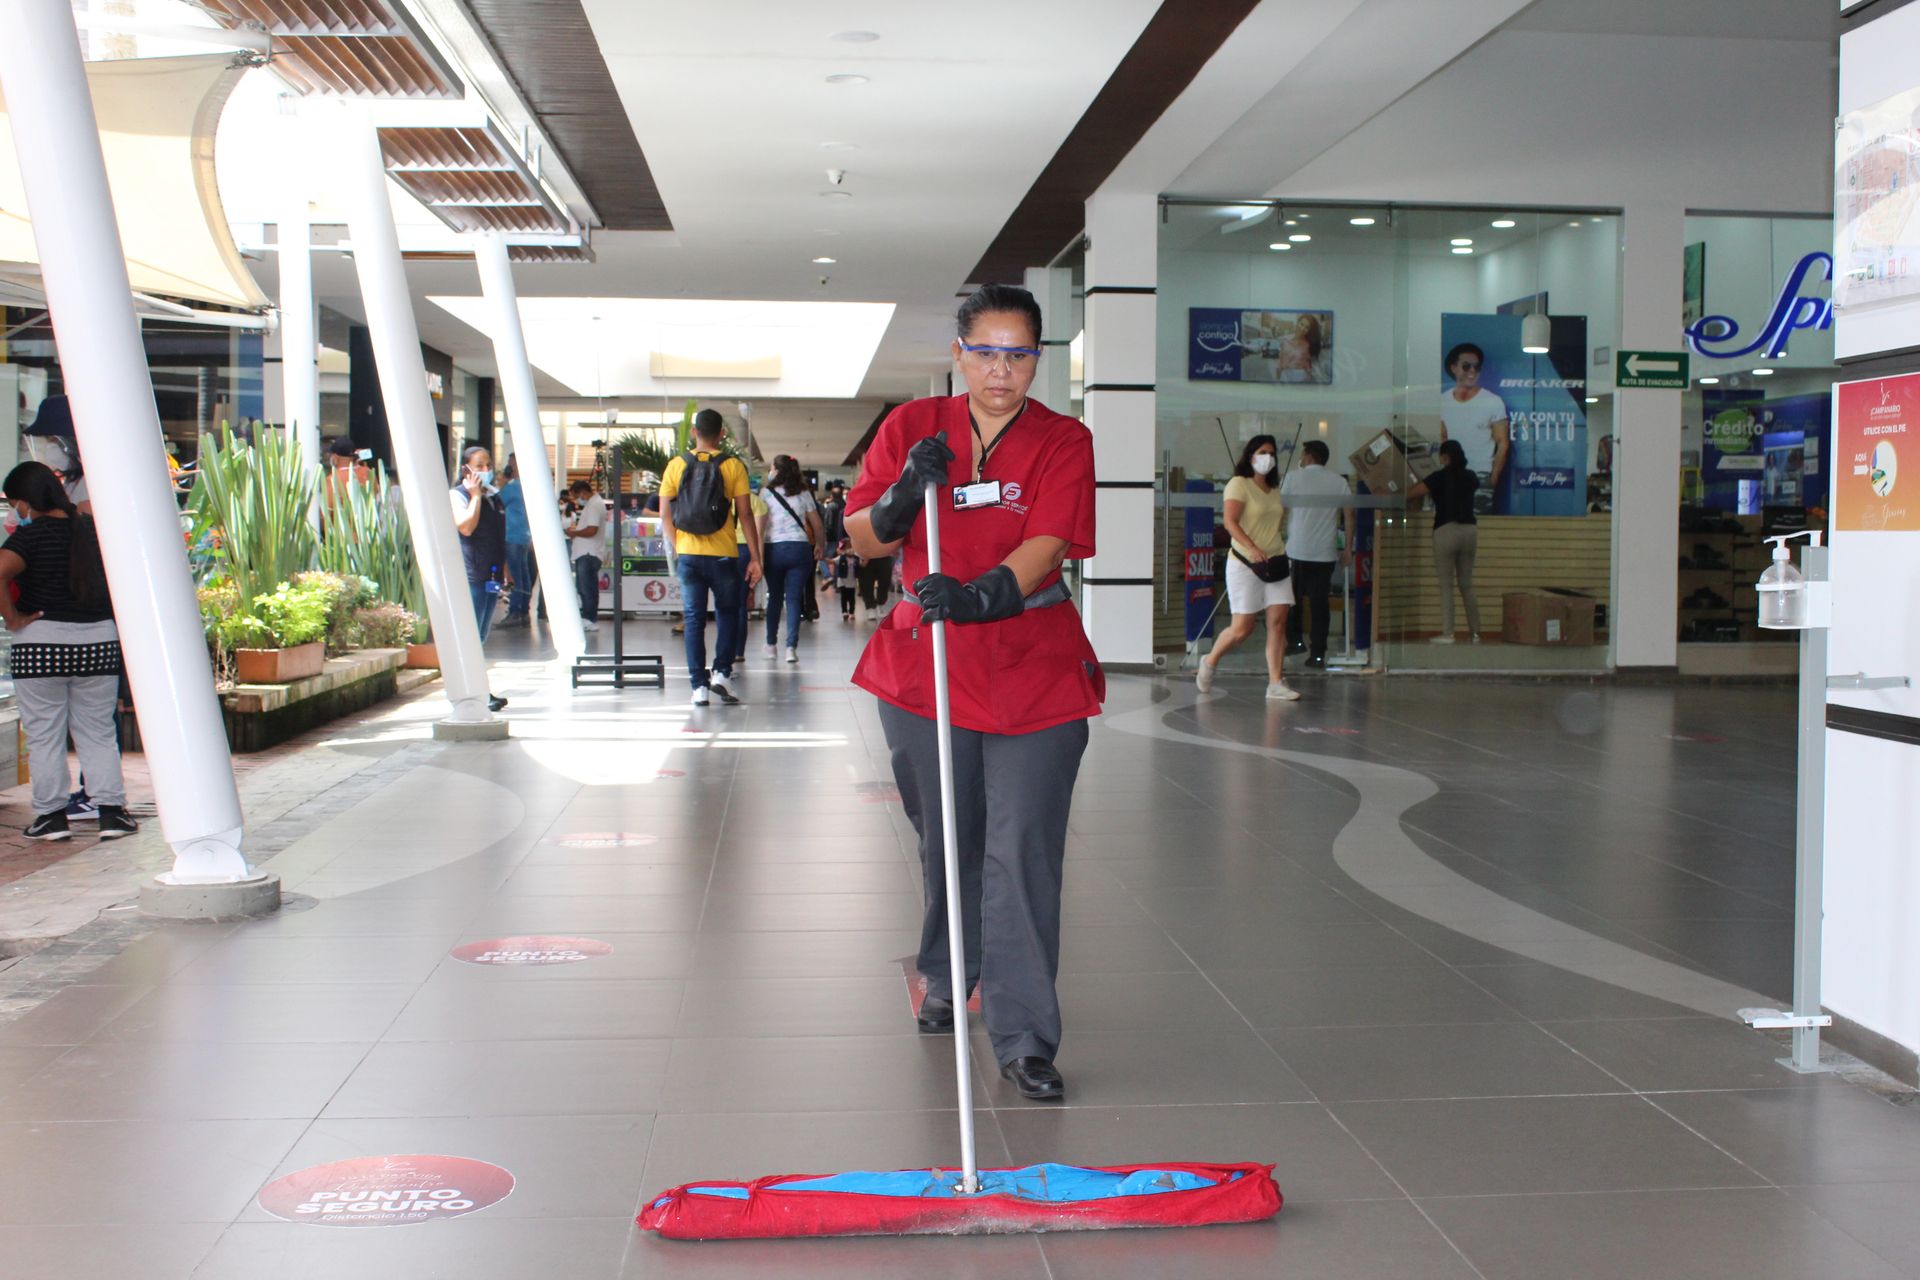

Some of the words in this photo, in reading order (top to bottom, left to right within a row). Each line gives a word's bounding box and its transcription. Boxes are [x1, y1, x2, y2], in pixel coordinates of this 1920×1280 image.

[1500, 379, 1585, 388] BREAKER
[1638, 378, 1646, 386] DE
[1530, 412, 1556, 422] CON
[1560, 412, 1575, 423] TU
[1510, 422, 1575, 441] ESTILO
[1703, 419, 1764, 436] Crédito
[1881, 425, 1893, 434] CON
[1188, 552, 1215, 576] SALE
[310, 1189, 462, 1203] PUNTO
[295, 1199, 474, 1214] SEGURO
[322, 1212, 396, 1221] Distancia
